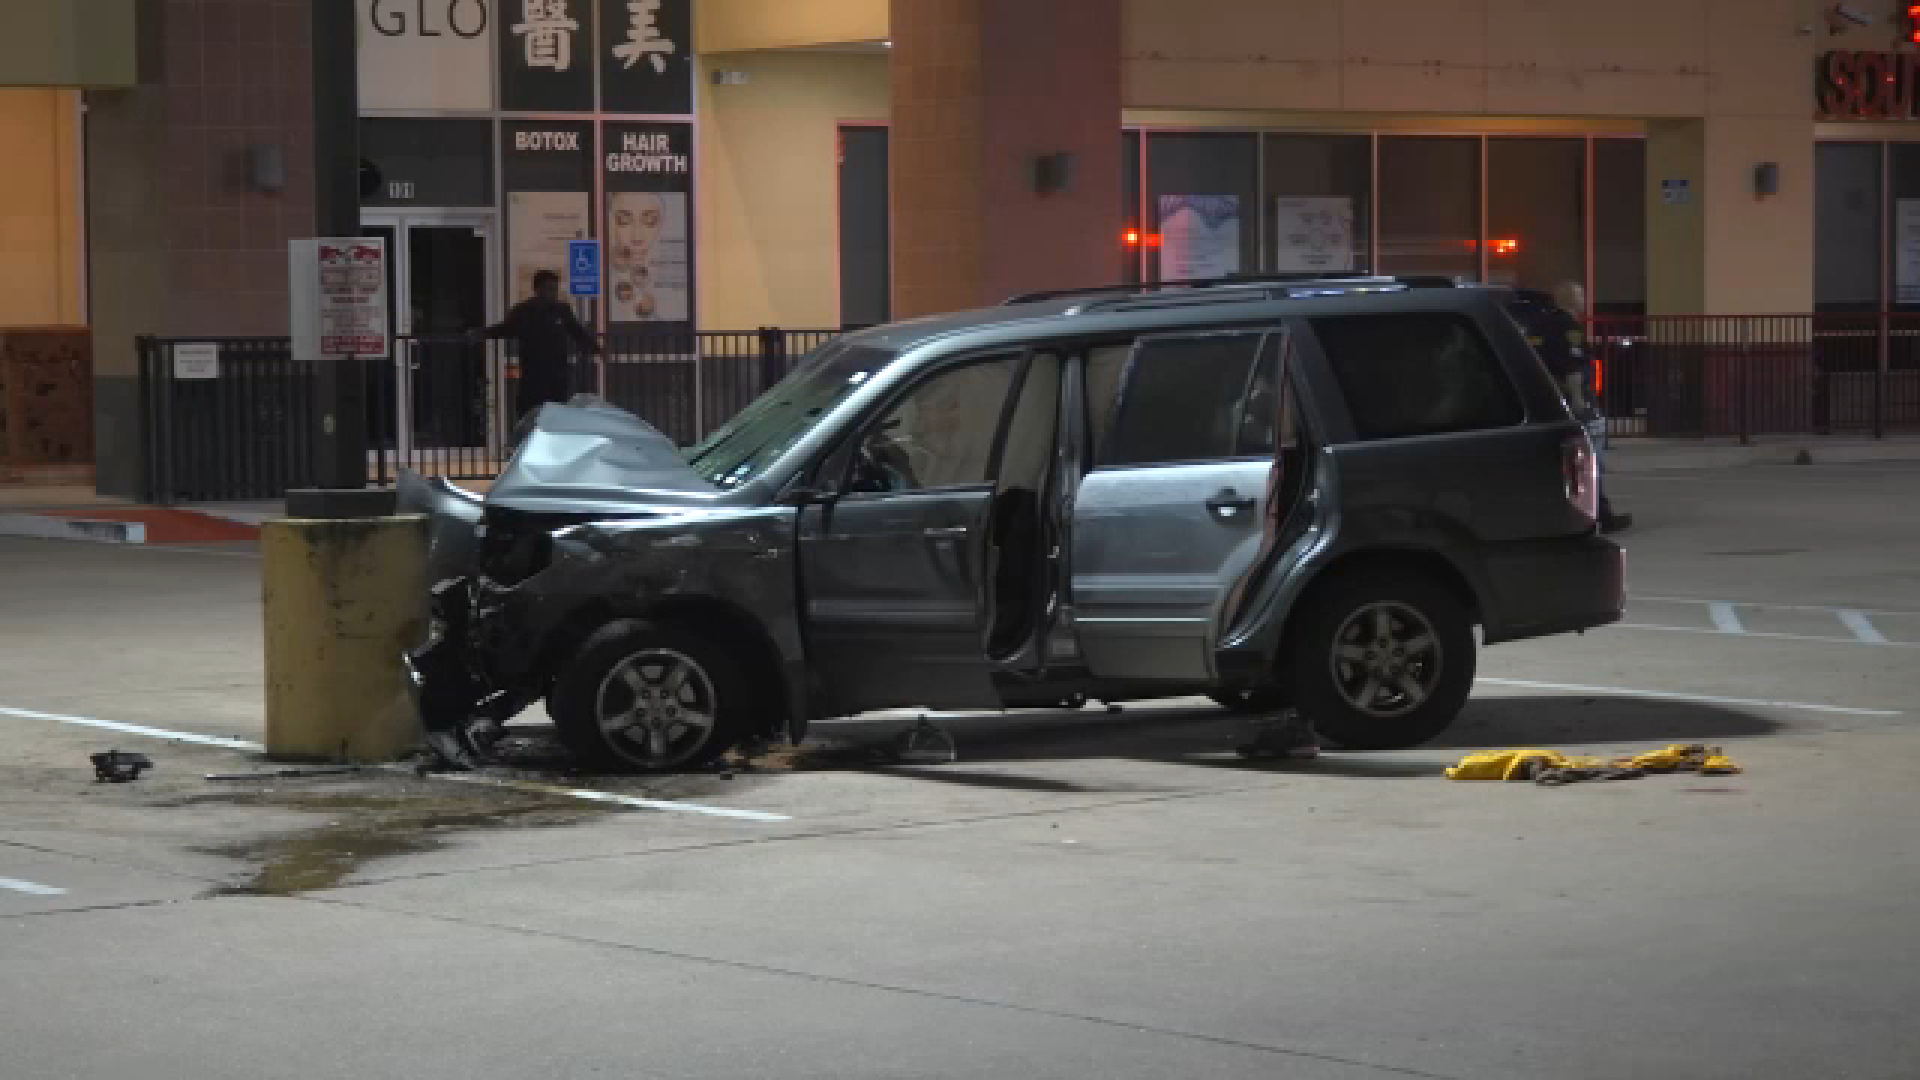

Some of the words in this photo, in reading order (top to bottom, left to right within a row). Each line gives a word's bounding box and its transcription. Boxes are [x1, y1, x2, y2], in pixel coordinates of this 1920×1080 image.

[371, 0, 487, 38] GLO
[515, 131, 580, 151] BOTOX
[622, 133, 670, 153] HAIR
[605, 152, 688, 173] GROWTH
